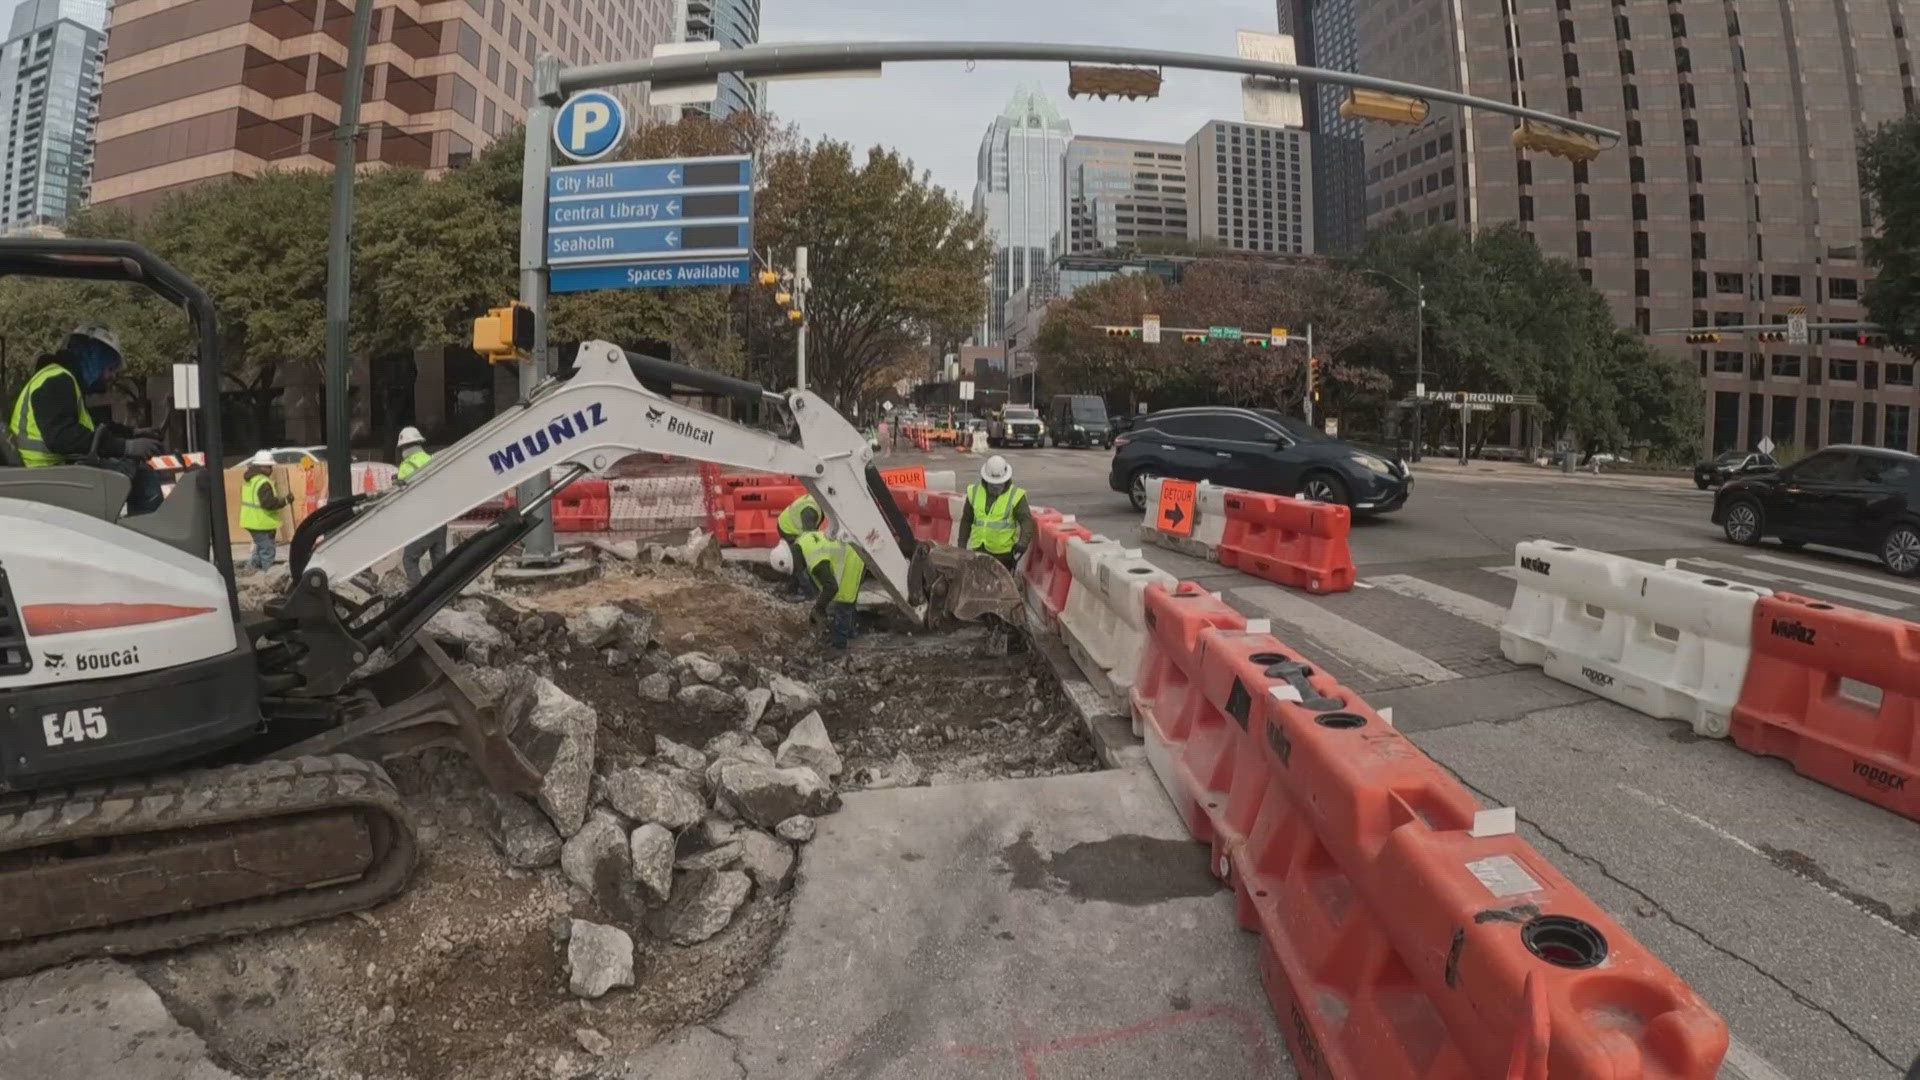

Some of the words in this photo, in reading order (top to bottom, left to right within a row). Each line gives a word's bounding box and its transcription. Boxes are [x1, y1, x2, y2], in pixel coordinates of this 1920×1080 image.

[571, 102, 610, 150] P
[556, 176, 581, 194] City
[587, 173, 614, 189] Hall
[555, 205, 604, 222] Central
[610, 202, 659, 220] Library
[554, 234, 615, 253] Seaholm
[627, 267, 673, 284] Spaces
[677, 264, 740, 281] Available
[488, 402, 608, 475] MUÑIZ
[1164, 487, 1193, 502] DETOUR
[42, 706, 108, 747] E45
